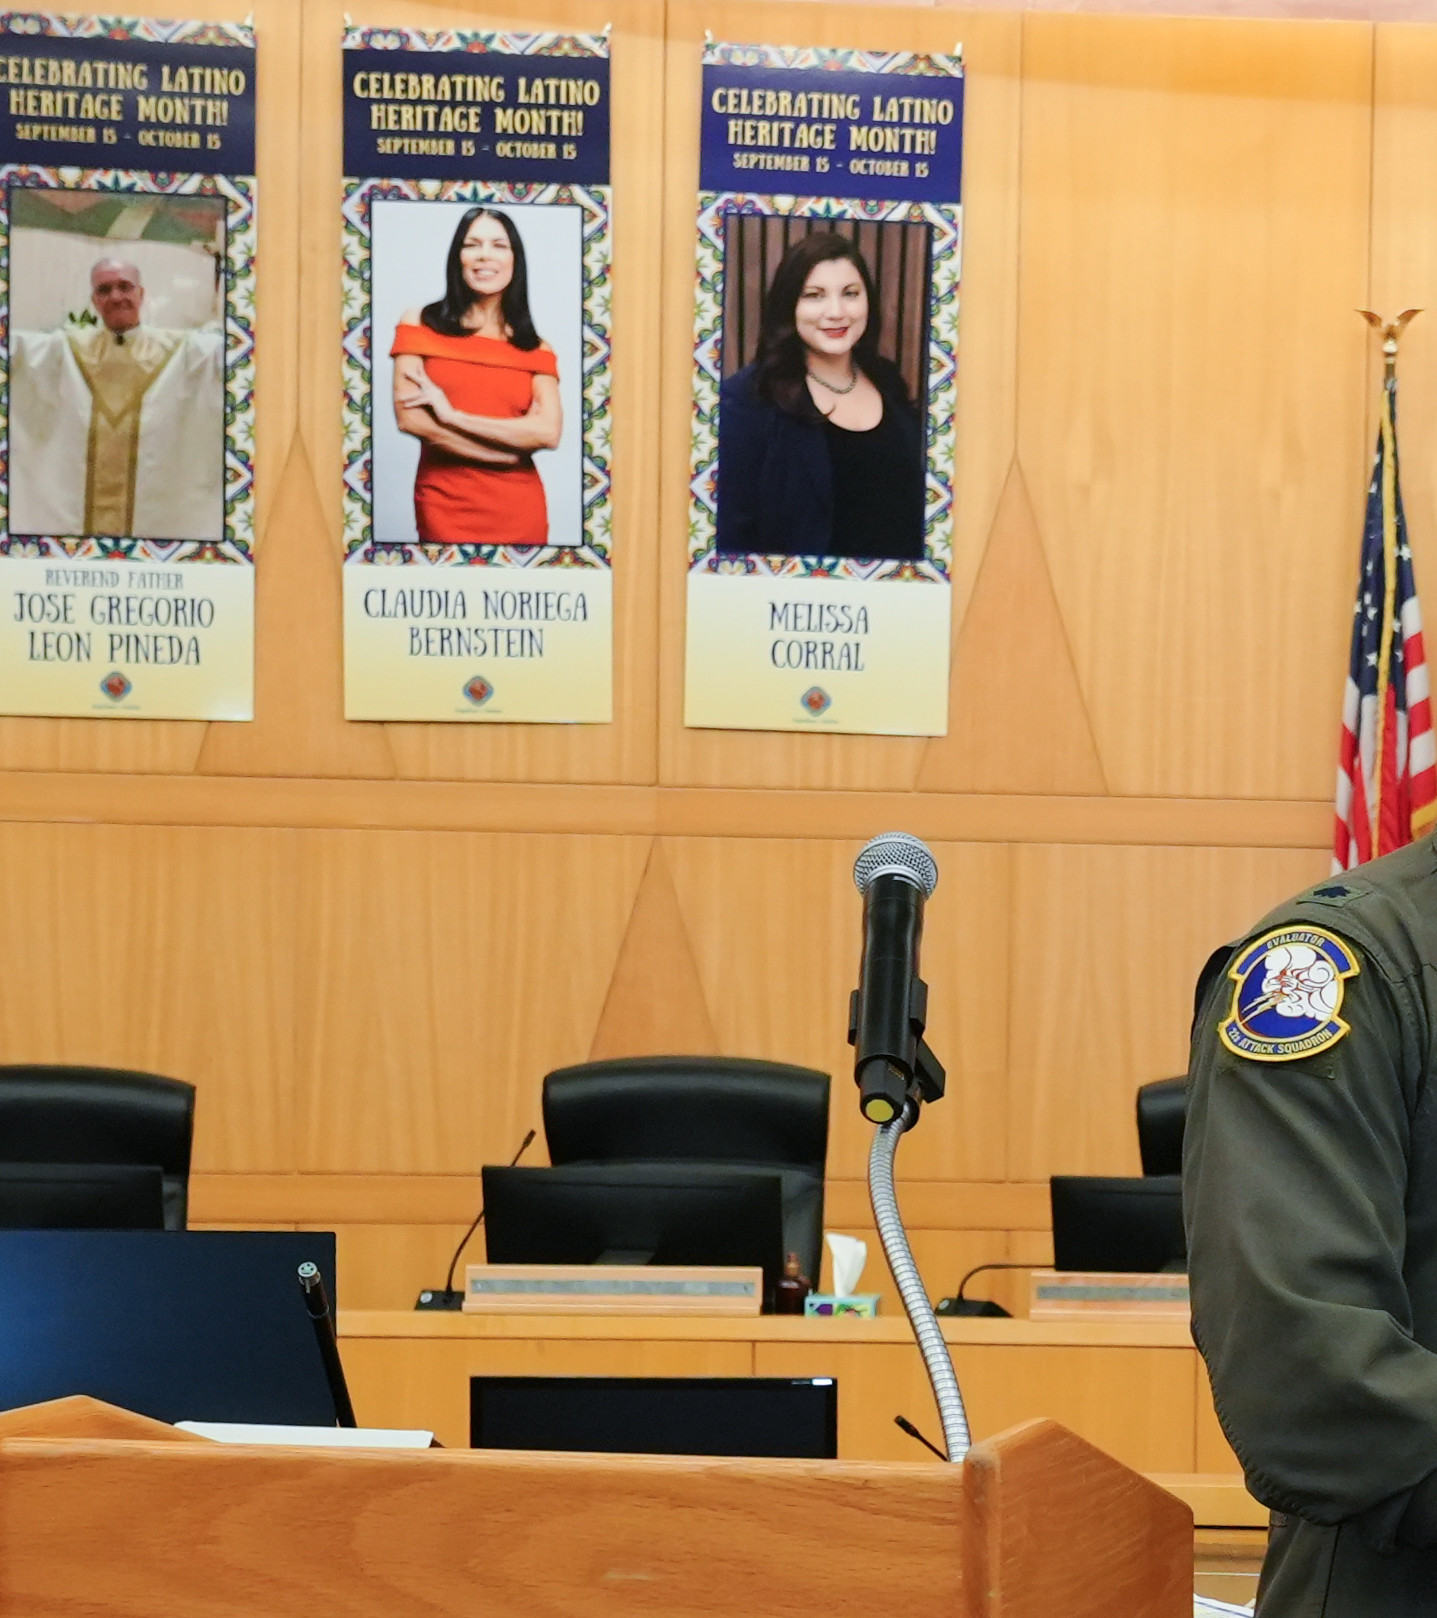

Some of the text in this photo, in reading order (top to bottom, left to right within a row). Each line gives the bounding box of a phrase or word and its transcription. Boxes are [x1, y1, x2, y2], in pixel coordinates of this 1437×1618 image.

[161, 64, 246, 96] LATINO
[353, 71, 601, 106] CELEBRATING LATINO
[10, 88, 229, 126] HERITAGE MONTH!
[370, 103, 584, 136] HERITAGE MONTH!
[712, 87, 954, 126] CELEBRATING LATINO
[727, 118, 937, 155] HERITAGE MONTH!
[733, 153, 929, 178] SEPTEMBER 15 OCTOBER 15
[46, 569, 184, 590] REVEREND FATHER
[14, 593, 215, 628] JOSE GREGORIO
[364, 588, 588, 622] CLAUDIA NORIEGA
[768, 602, 870, 635] MELISSA
[28, 631, 201, 666] LEON PINEDA
[409, 627, 544, 658] BERNSTEIN
[771, 639, 865, 672] CORRAL
[1240, 1028, 1332, 1053] ATTACK SQUADRON
